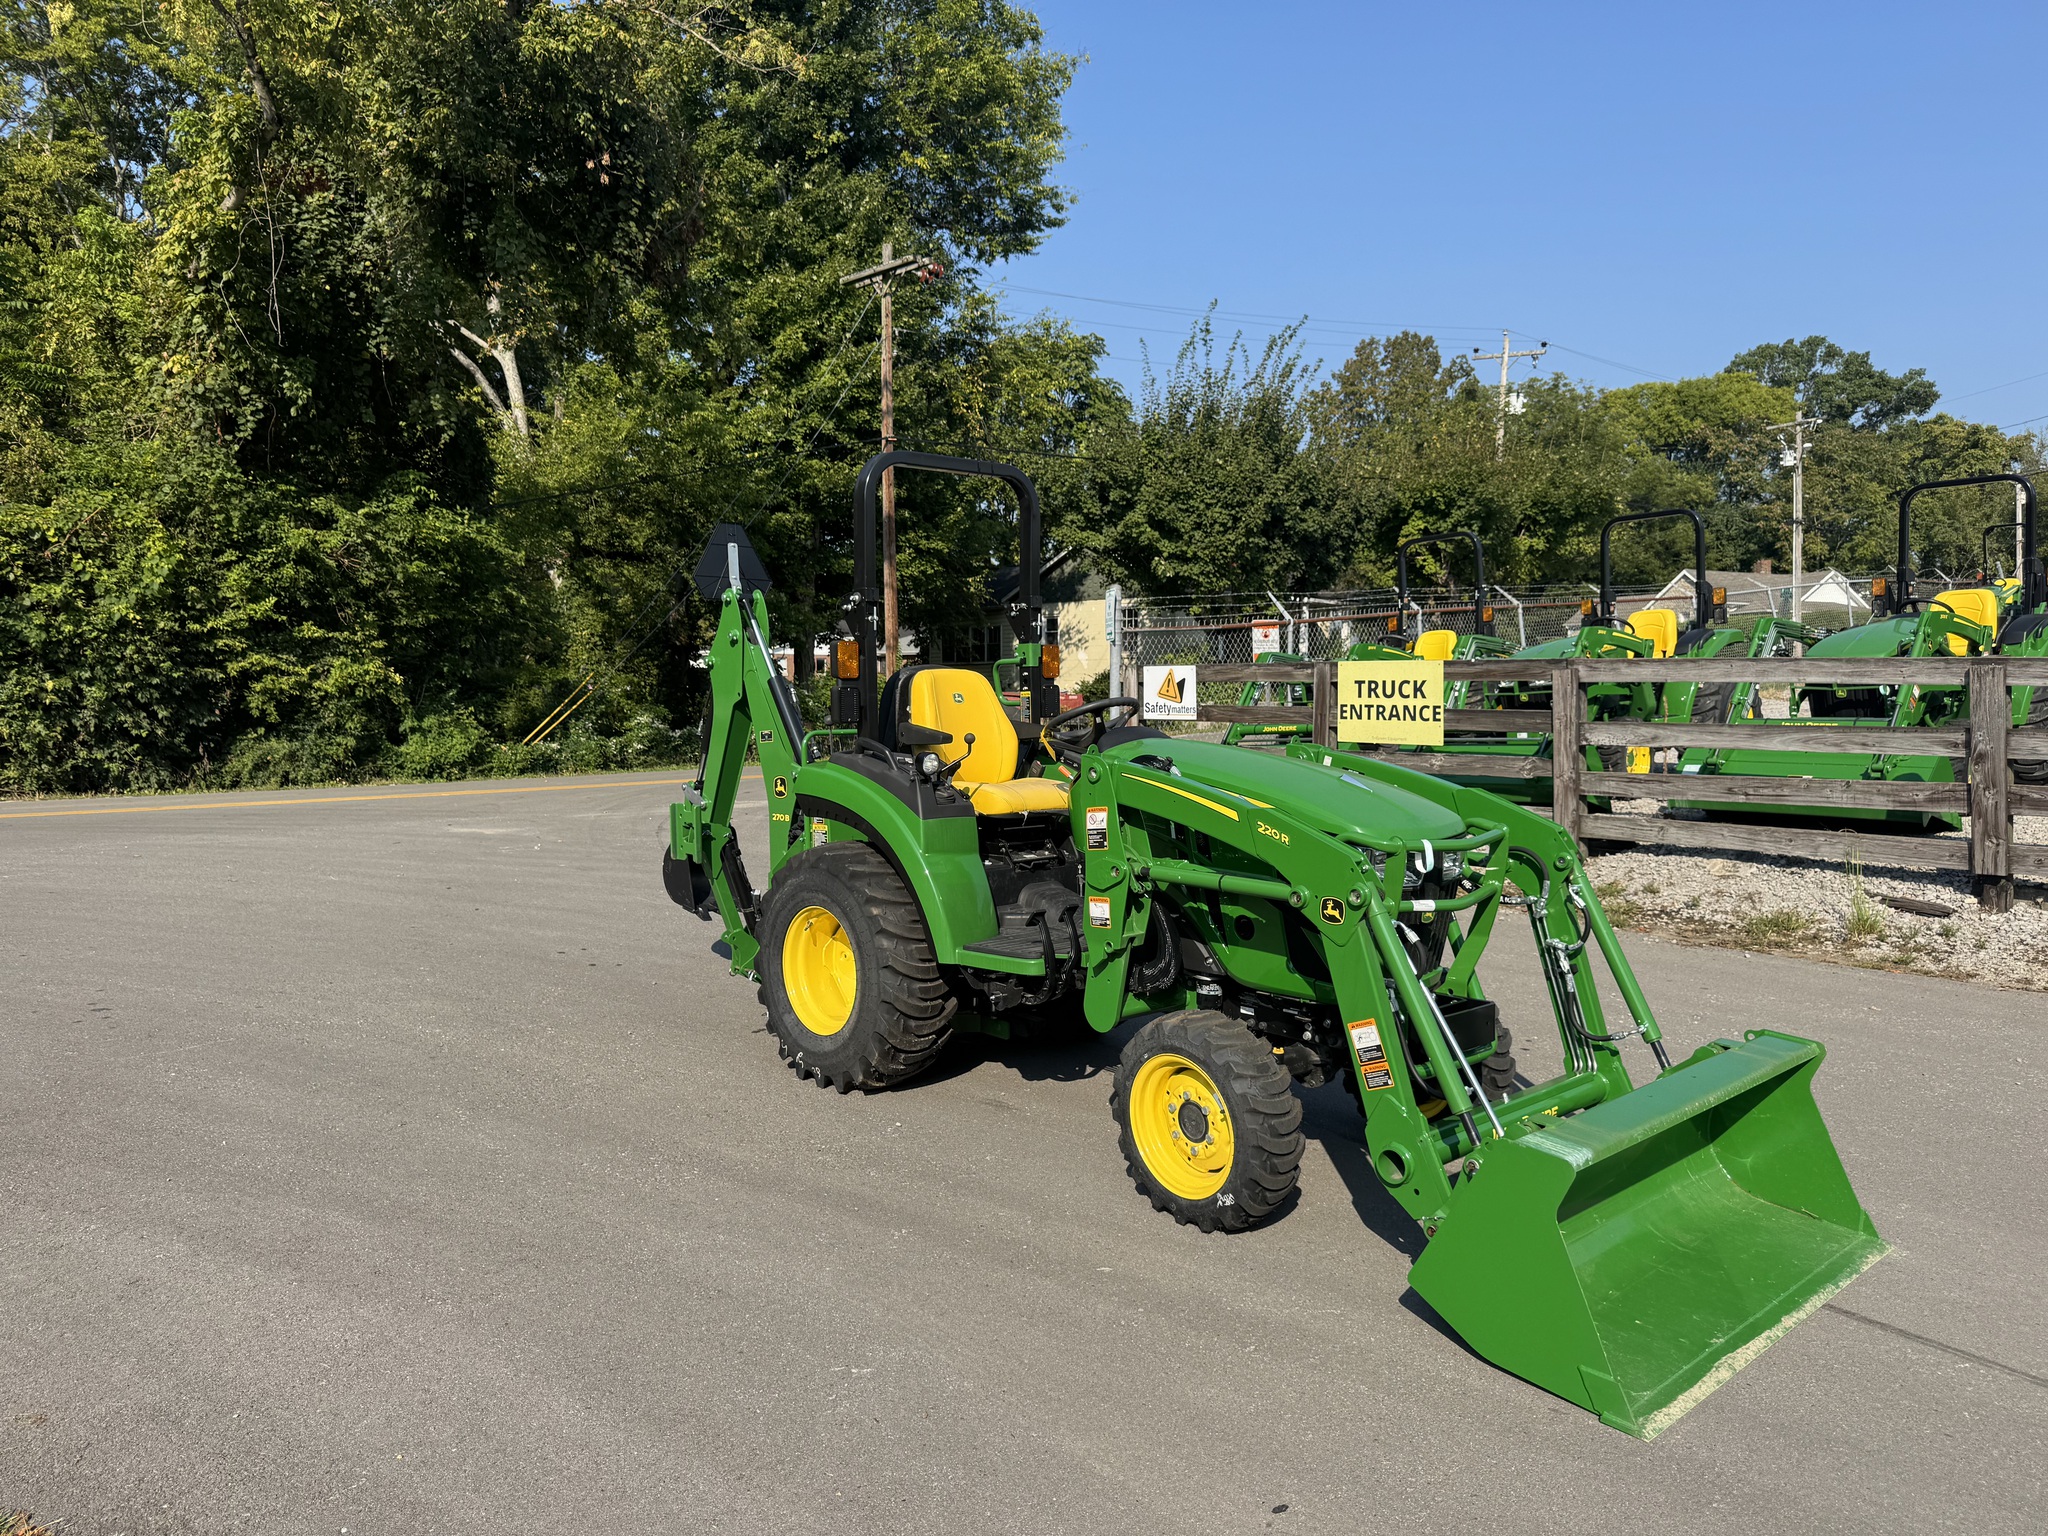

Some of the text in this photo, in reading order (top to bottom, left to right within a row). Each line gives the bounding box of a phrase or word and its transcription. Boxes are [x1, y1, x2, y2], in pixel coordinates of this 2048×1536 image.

[1354, 680, 1427, 699] TRUCK
[1145, 702, 1197, 716] Safety matters
[1340, 704, 1442, 722] ENTRANCE
